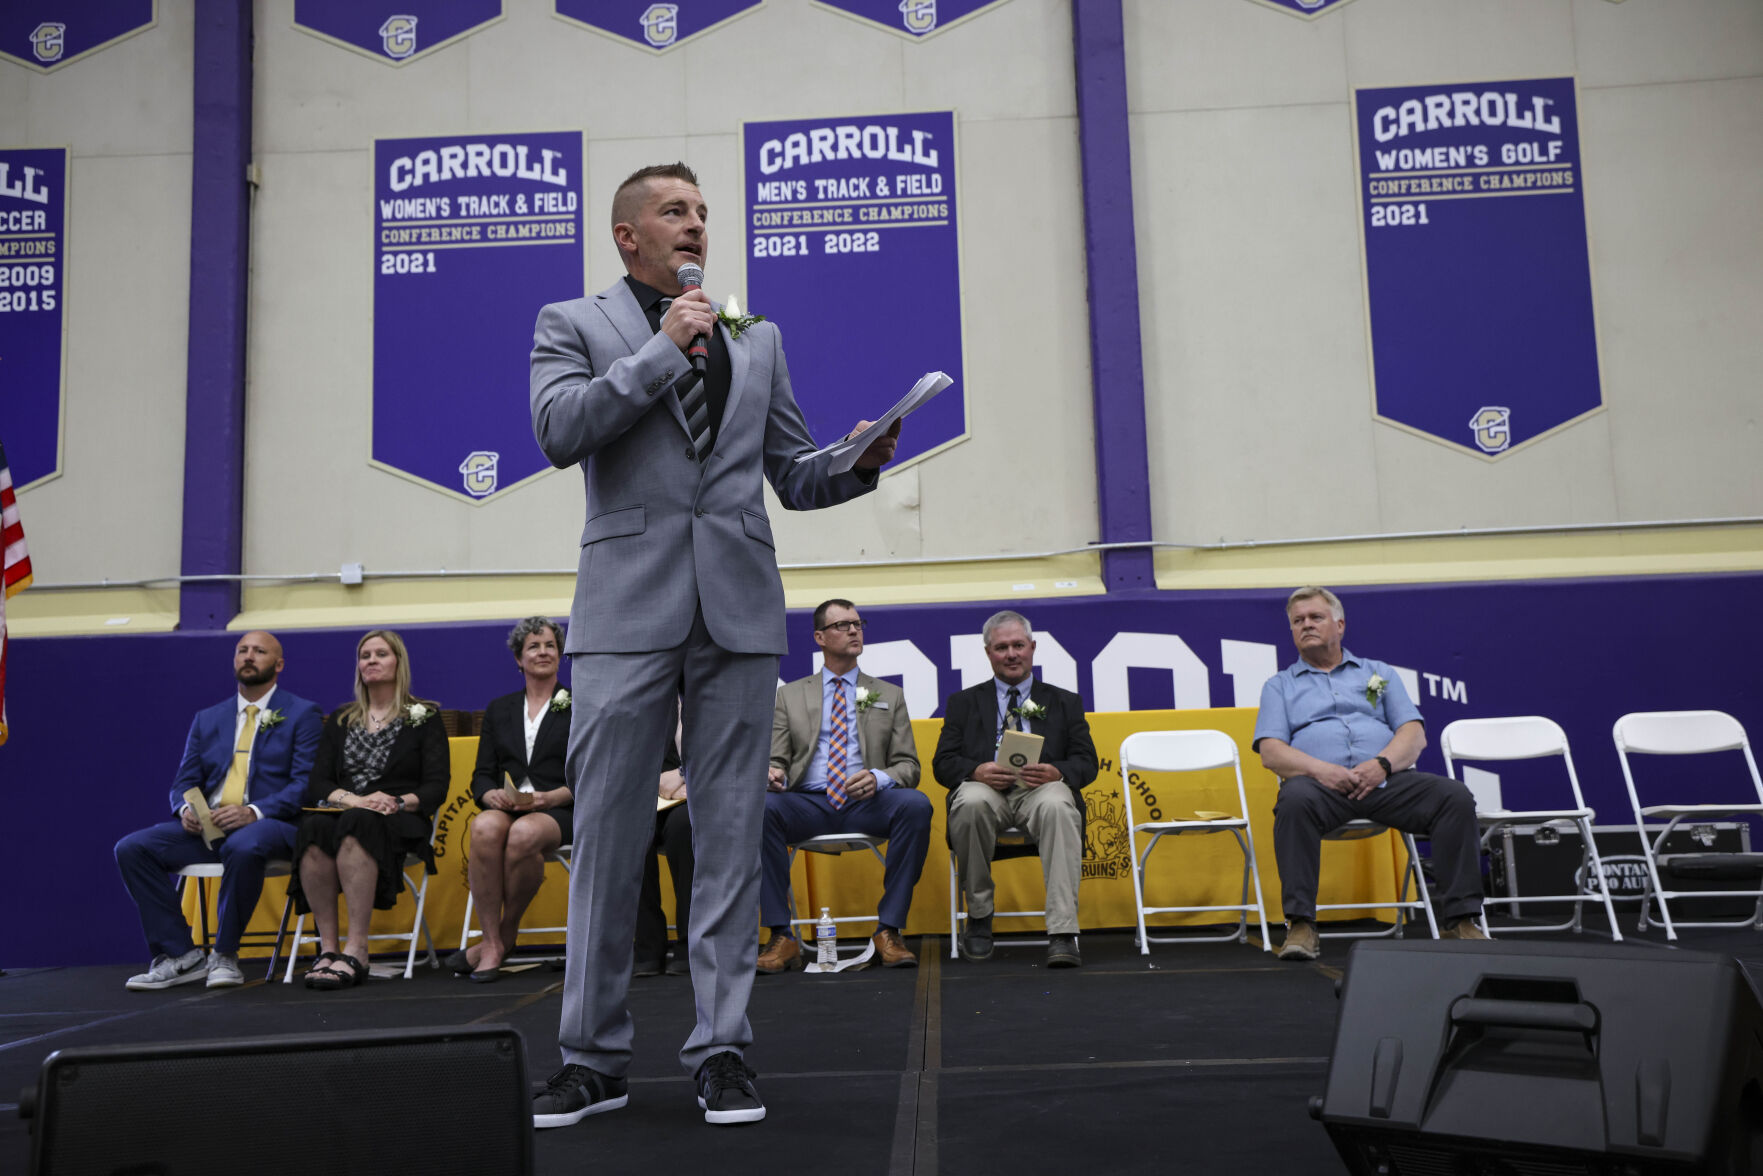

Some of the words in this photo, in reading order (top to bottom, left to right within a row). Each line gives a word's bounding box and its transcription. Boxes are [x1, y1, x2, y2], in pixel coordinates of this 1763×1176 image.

[1373, 92, 1561, 143] CARROLL
[759, 125, 938, 175] CARROLL
[1376, 145, 1489, 171] WOMEN'S
[1501, 141, 1562, 164] GOLF
[390, 143, 567, 192] CARROLL
[758, 180, 807, 202] MEN'S
[814, 177, 870, 199] TRACK
[876, 176, 890, 197] &
[896, 173, 942, 195] FIELD
[1370, 176, 1473, 195] CONFERENCE
[1480, 171, 1573, 190] CHAMPIONS
[380, 196, 450, 220] WOMEN'S
[457, 194, 510, 216] TRACK
[514, 193, 528, 214] &
[534, 191, 577, 213] FIELD
[753, 208, 853, 226] CONFERENCE
[859, 204, 948, 221] CHAMPIONS
[1371, 203, 1429, 227] 2021
[381, 226, 481, 244] CONFERENCE
[487, 222, 575, 239] CHAMPIONS
[754, 235, 808, 257] 2021
[825, 232, 879, 254] 2022
[381, 252, 436, 275] 2021
[0, 265, 55, 287] 2009
[0, 290, 56, 312] 2015
[433, 789, 474, 858] CAPITAL
[1081, 860, 1116, 877] RUINS
[1588, 863, 1650, 878] ONTAN
[1587, 877, 1619, 890] PO
